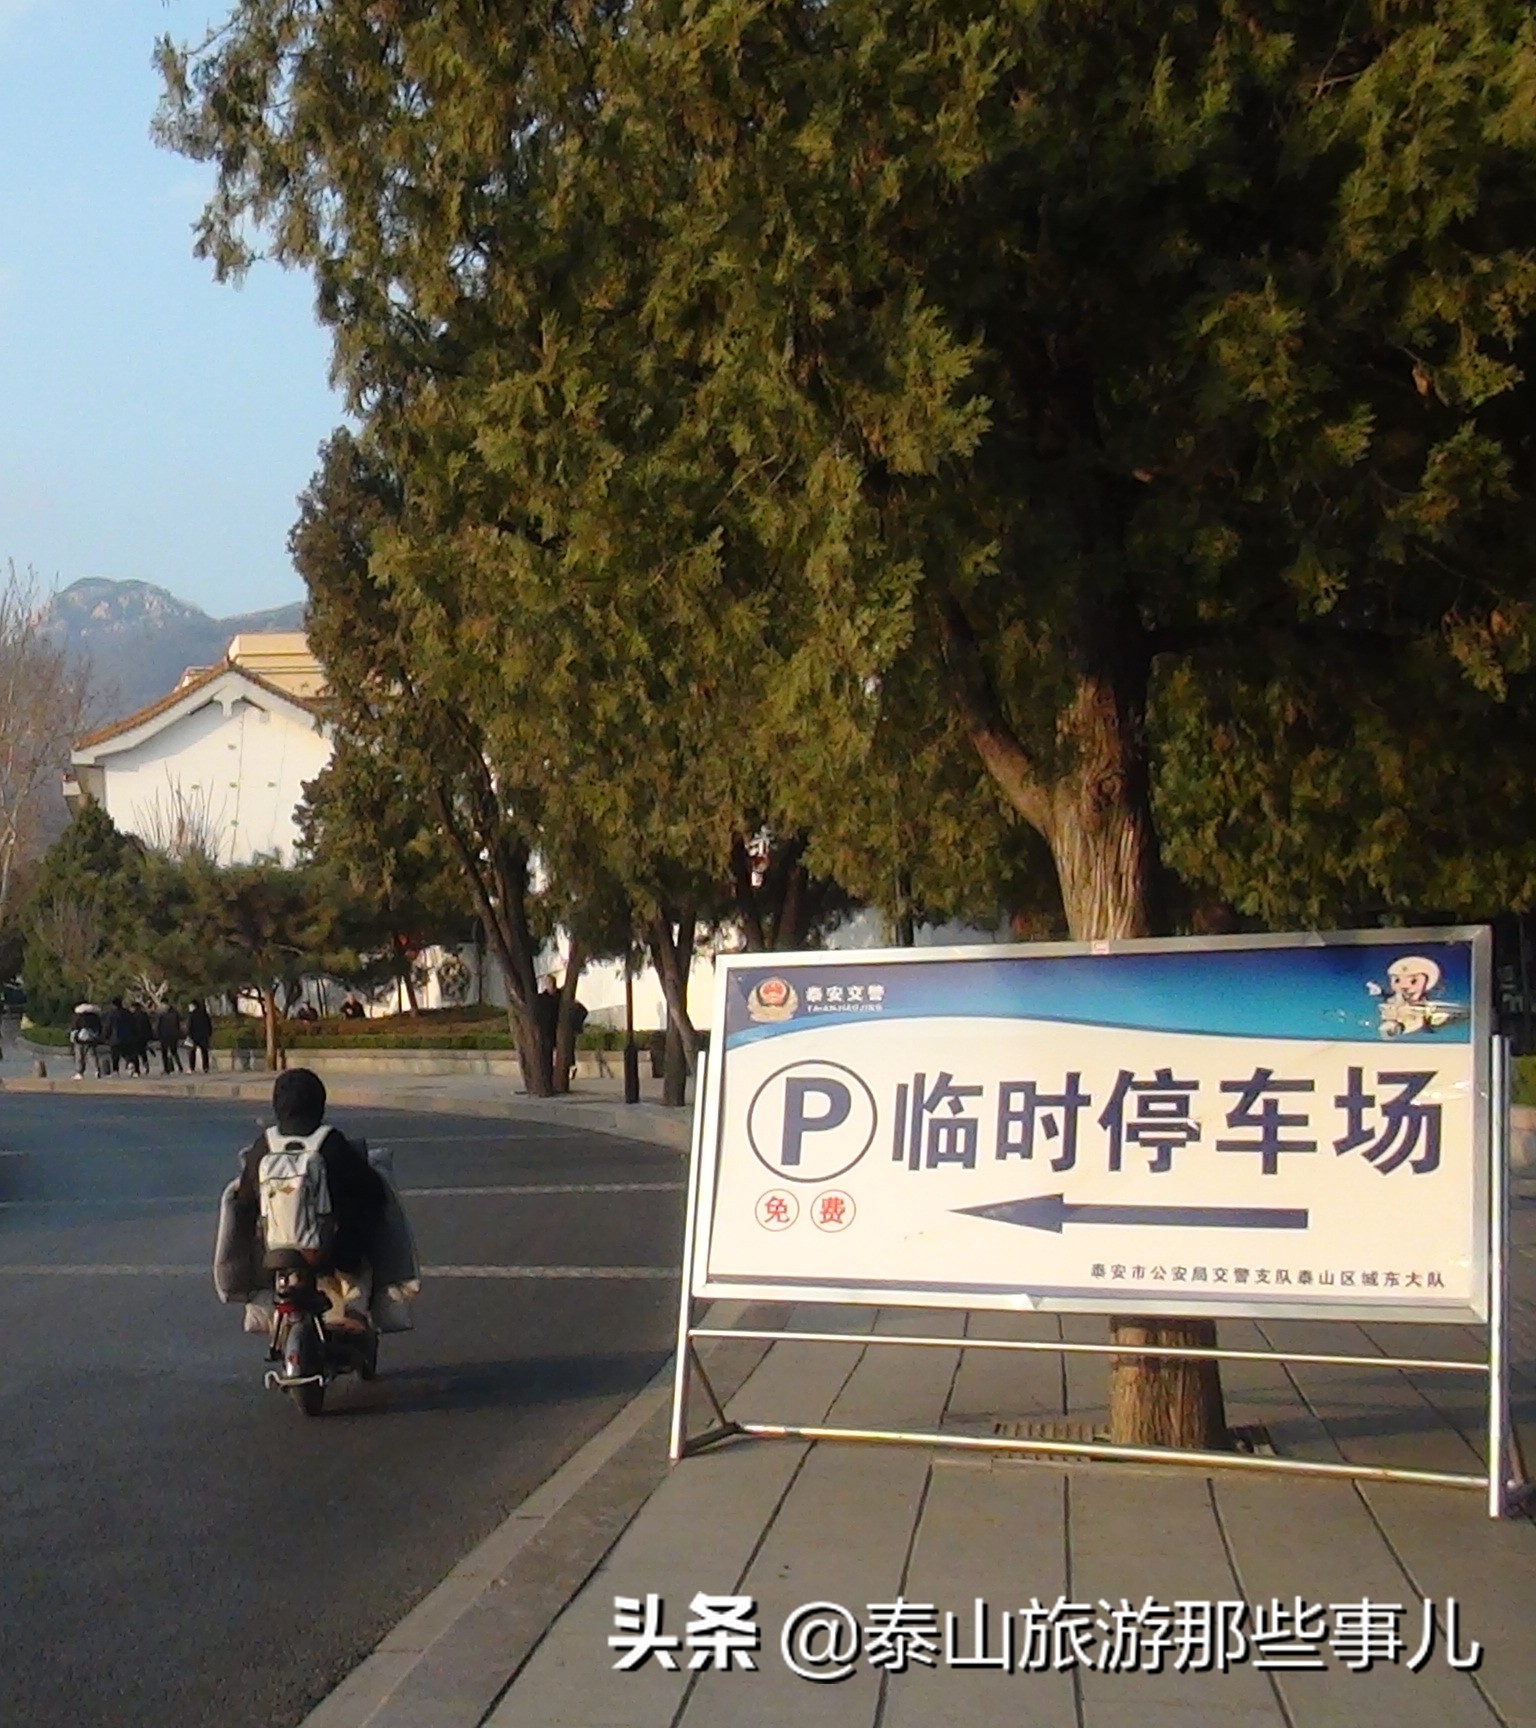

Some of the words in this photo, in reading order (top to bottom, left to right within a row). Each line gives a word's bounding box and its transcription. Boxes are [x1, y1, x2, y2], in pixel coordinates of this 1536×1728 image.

[805, 984, 884, 1002] 泰安交警
[780, 1077, 852, 1166] P
[892, 1066, 1443, 1175] 临时停车场
